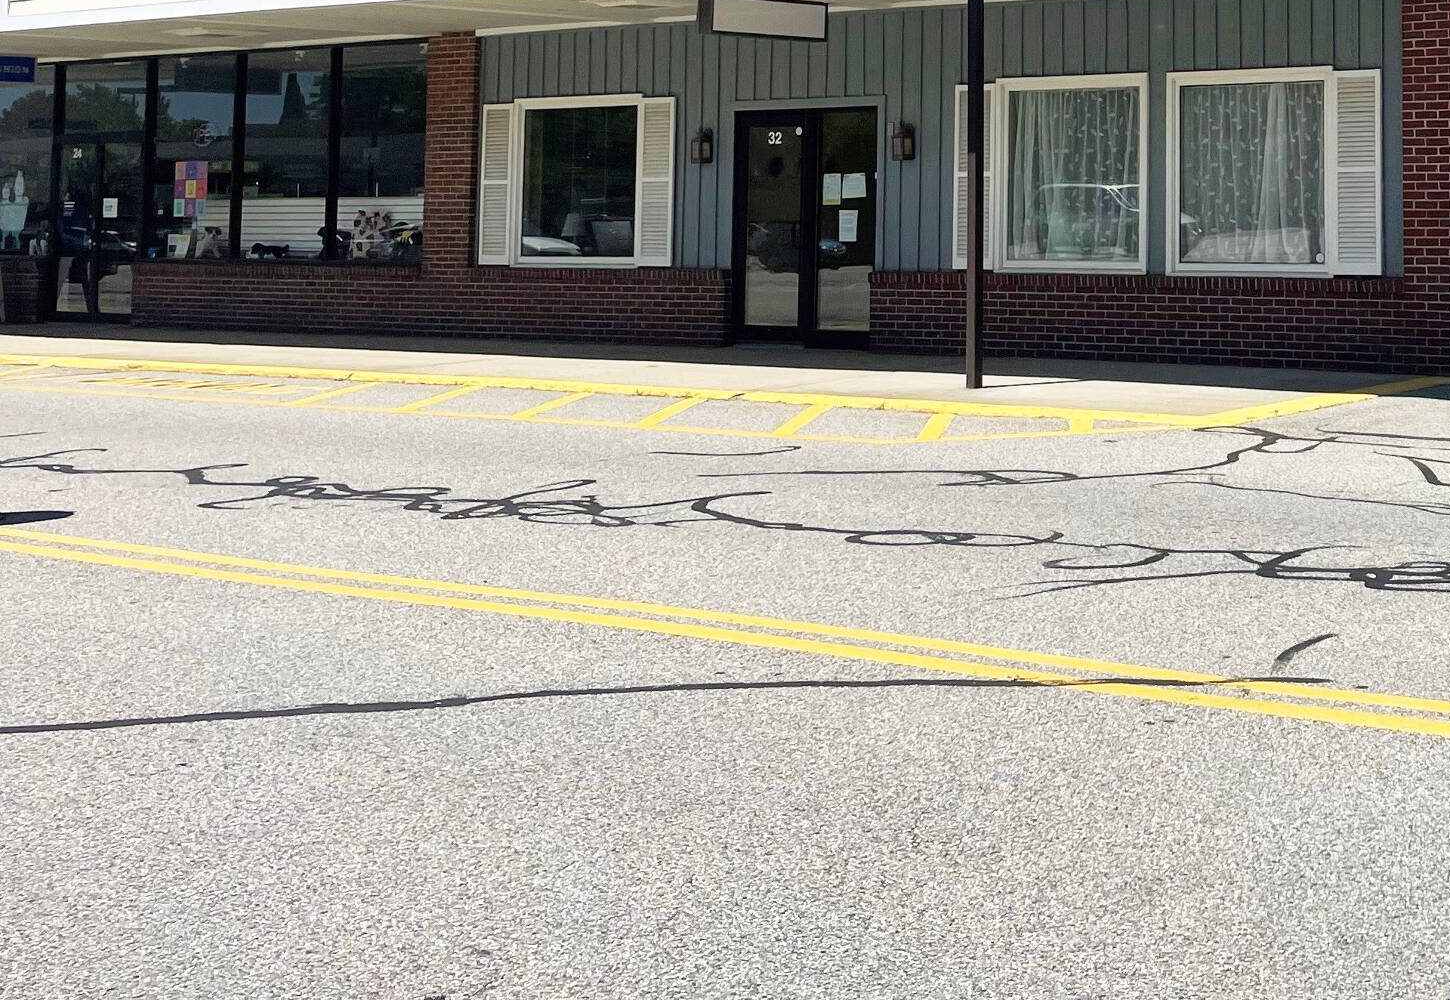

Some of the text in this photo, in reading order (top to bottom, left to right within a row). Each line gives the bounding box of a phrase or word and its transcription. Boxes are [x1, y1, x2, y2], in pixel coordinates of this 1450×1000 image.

[0, 65, 30, 74] NION
[768, 131, 782, 145] 32
[72, 147, 82, 159] 24
